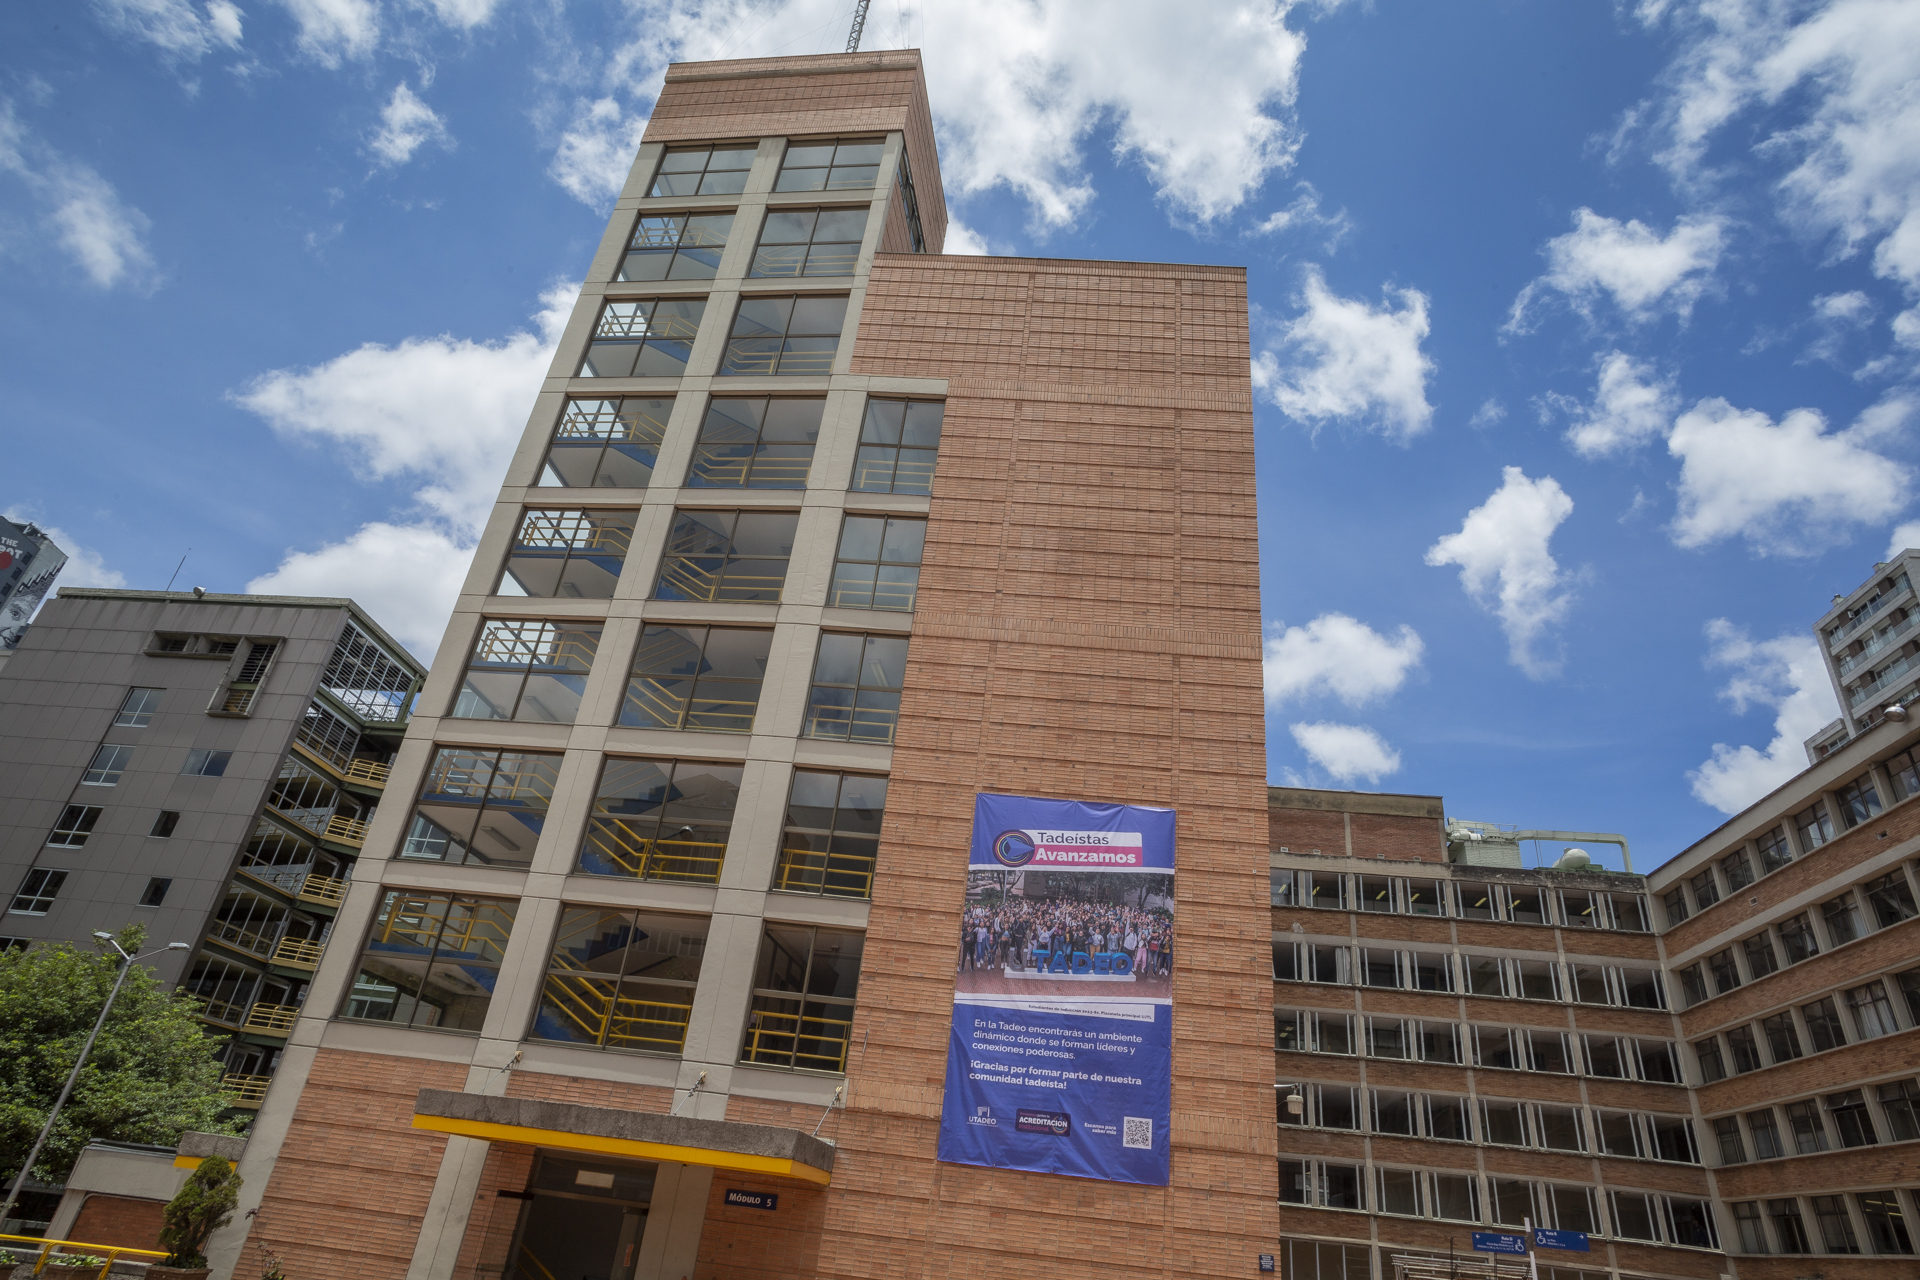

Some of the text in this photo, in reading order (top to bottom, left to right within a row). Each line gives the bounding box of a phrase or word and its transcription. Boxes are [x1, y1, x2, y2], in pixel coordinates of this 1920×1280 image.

[1, 537, 18, 547] THE
[1038, 832, 1109, 845] Tadeístas
[1035, 848, 1136, 864] Avanzamos
[975, 1019, 1142, 1043] En la Tadeo encontrarás un ambiente
[973, 1030, 1136, 1055] dinámico donde se forman líderes y
[972, 1042, 1076, 1060] conexiones poderosas.
[969, 1072, 1067, 1089] comunidad tadeísta!
[970, 1060, 1142, 1085] ¡Gracias por formar parte de nuestra
[968, 1116, 997, 1125] UTADEO
[729, 1192, 772, 1207] MÓDULO 5
